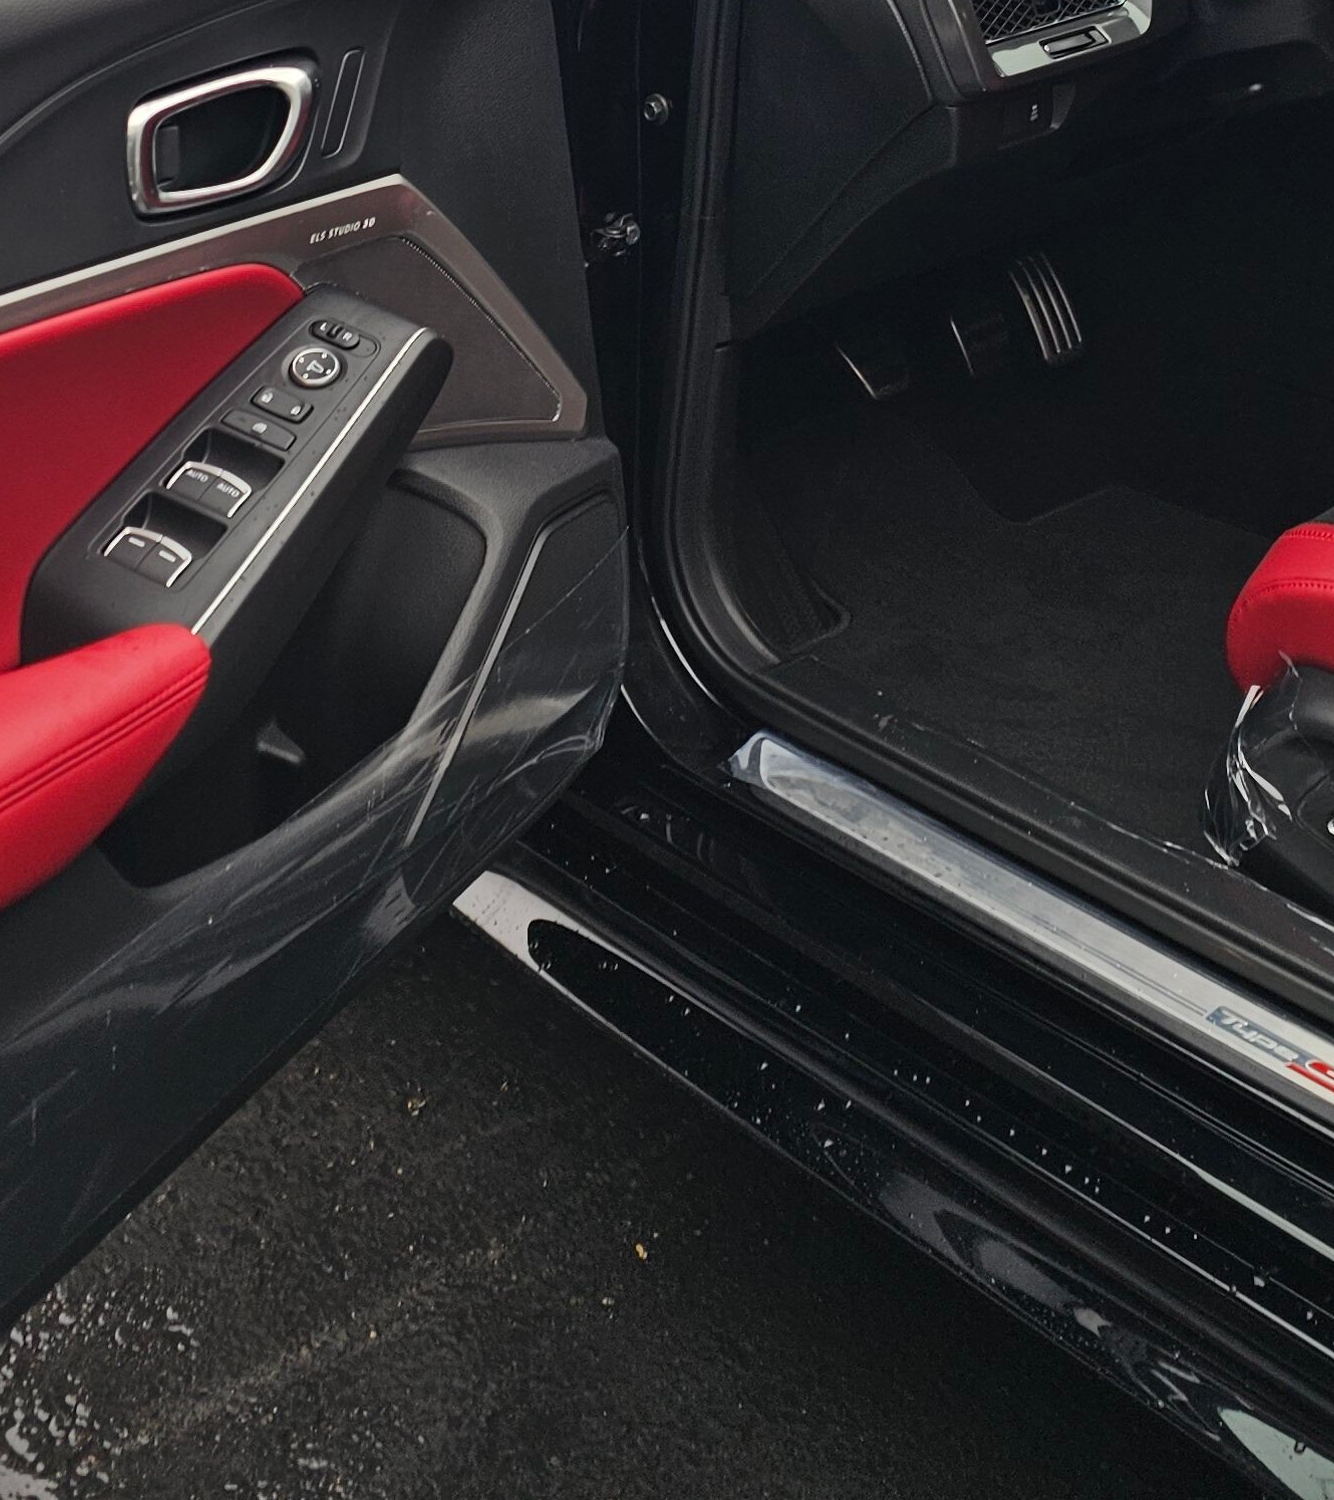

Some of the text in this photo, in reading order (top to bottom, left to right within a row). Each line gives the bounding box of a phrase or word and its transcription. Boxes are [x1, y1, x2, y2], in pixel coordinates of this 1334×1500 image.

[309, 230, 327, 244] ELS
[327, 220, 361, 240] STUDIO
[319, 321, 353, 342] L R
[186, 468, 209, 483] AUTO
[216, 481, 240, 498] AUTO
